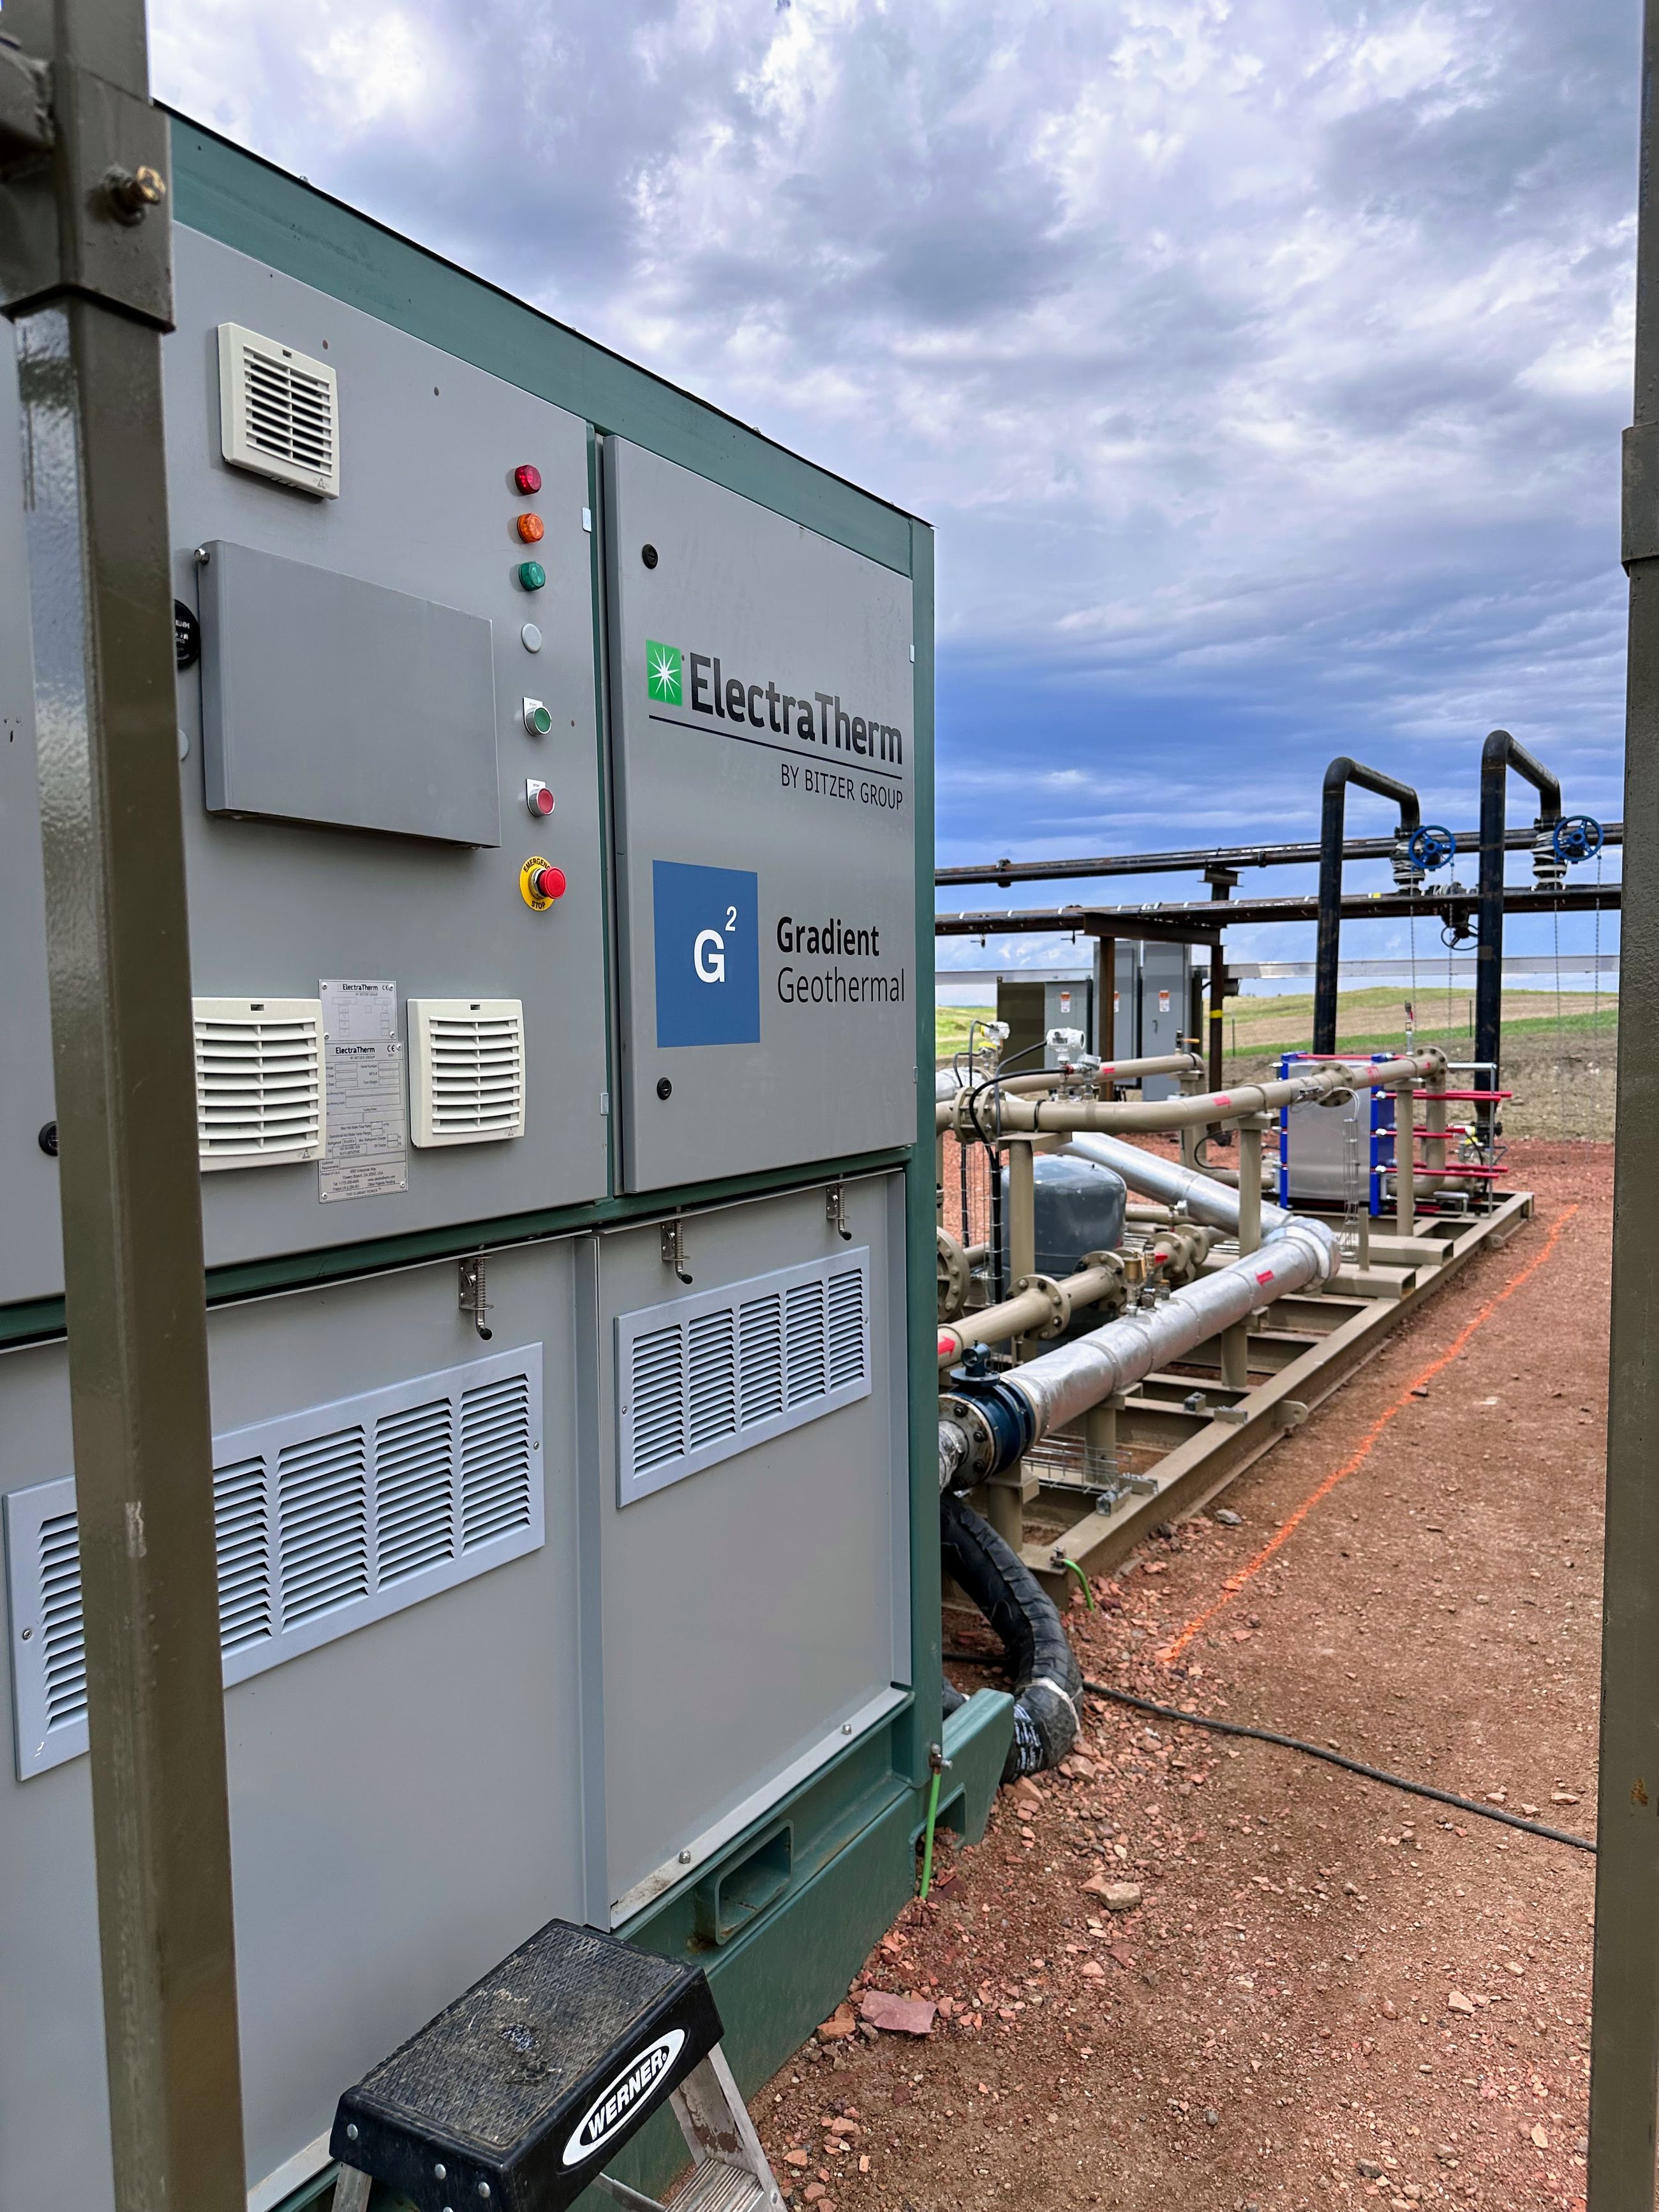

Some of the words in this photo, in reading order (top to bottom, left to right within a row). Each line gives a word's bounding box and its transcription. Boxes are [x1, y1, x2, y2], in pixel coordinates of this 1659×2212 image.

[690, 653, 902, 764] ElectraTherm
[781, 764, 798, 788] BY
[806, 769, 855, 801] BITZER
[861, 783, 902, 810] GROUP
[523, 858, 551, 872] EMERGENC
[532, 901, 546, 909] STOP
[777, 917, 880, 956] Gradient
[777, 967, 905, 1004] Geothermal
[588, 2049, 662, 2141] WERNER
